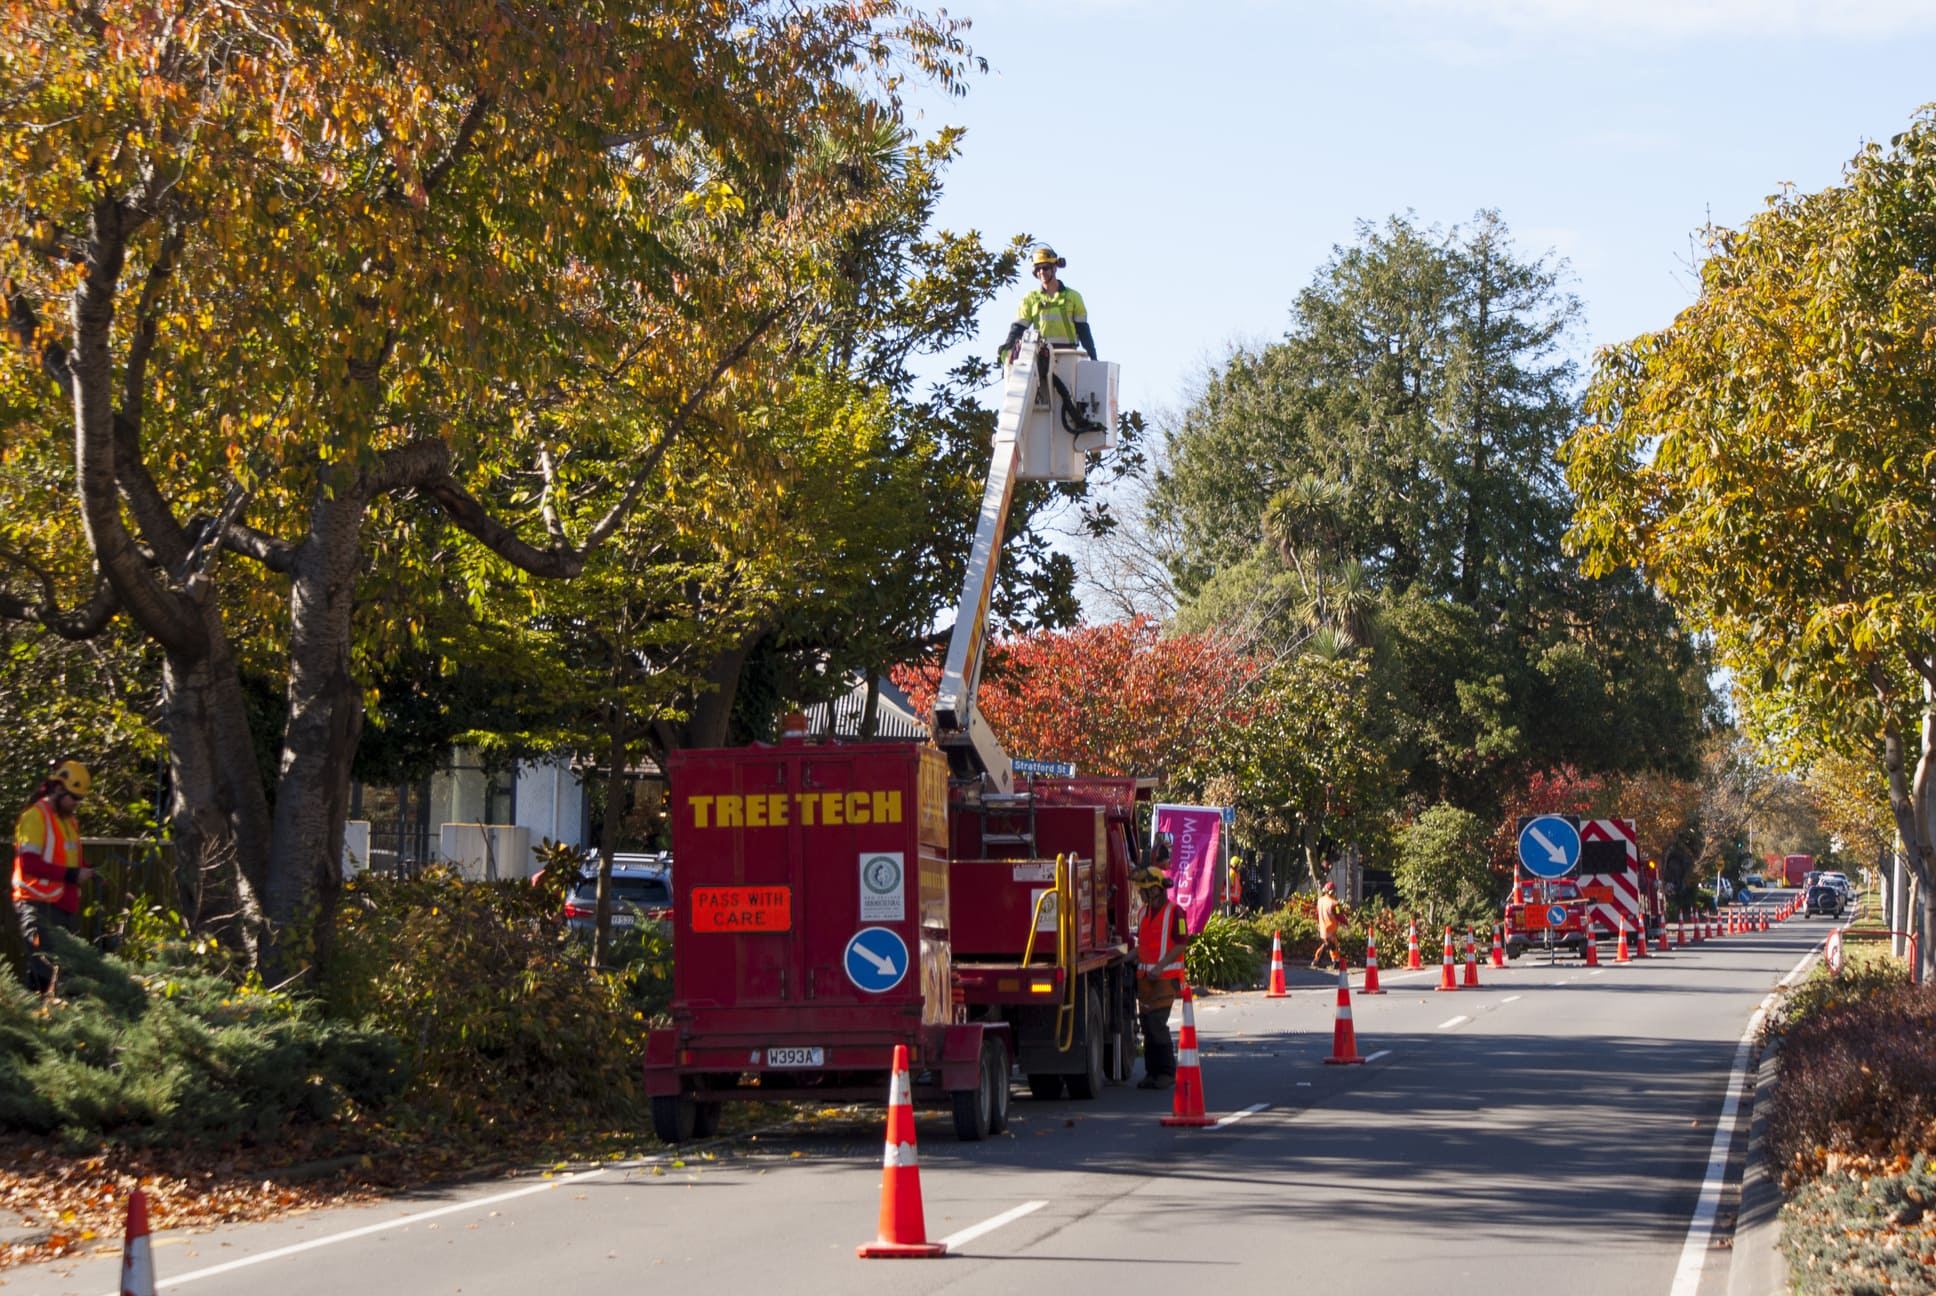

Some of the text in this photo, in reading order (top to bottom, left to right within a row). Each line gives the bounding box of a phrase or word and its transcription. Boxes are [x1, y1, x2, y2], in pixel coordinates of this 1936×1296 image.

[1014, 760, 1066, 774] Stratford St
[688, 794, 789, 828] TREE
[795, 790, 902, 825] TECH
[1178, 817, 1198, 888] Mother's
[699, 892, 784, 907] PASS WITH
[713, 911, 766, 926] CARE
[769, 1049, 814, 1065] W393A
